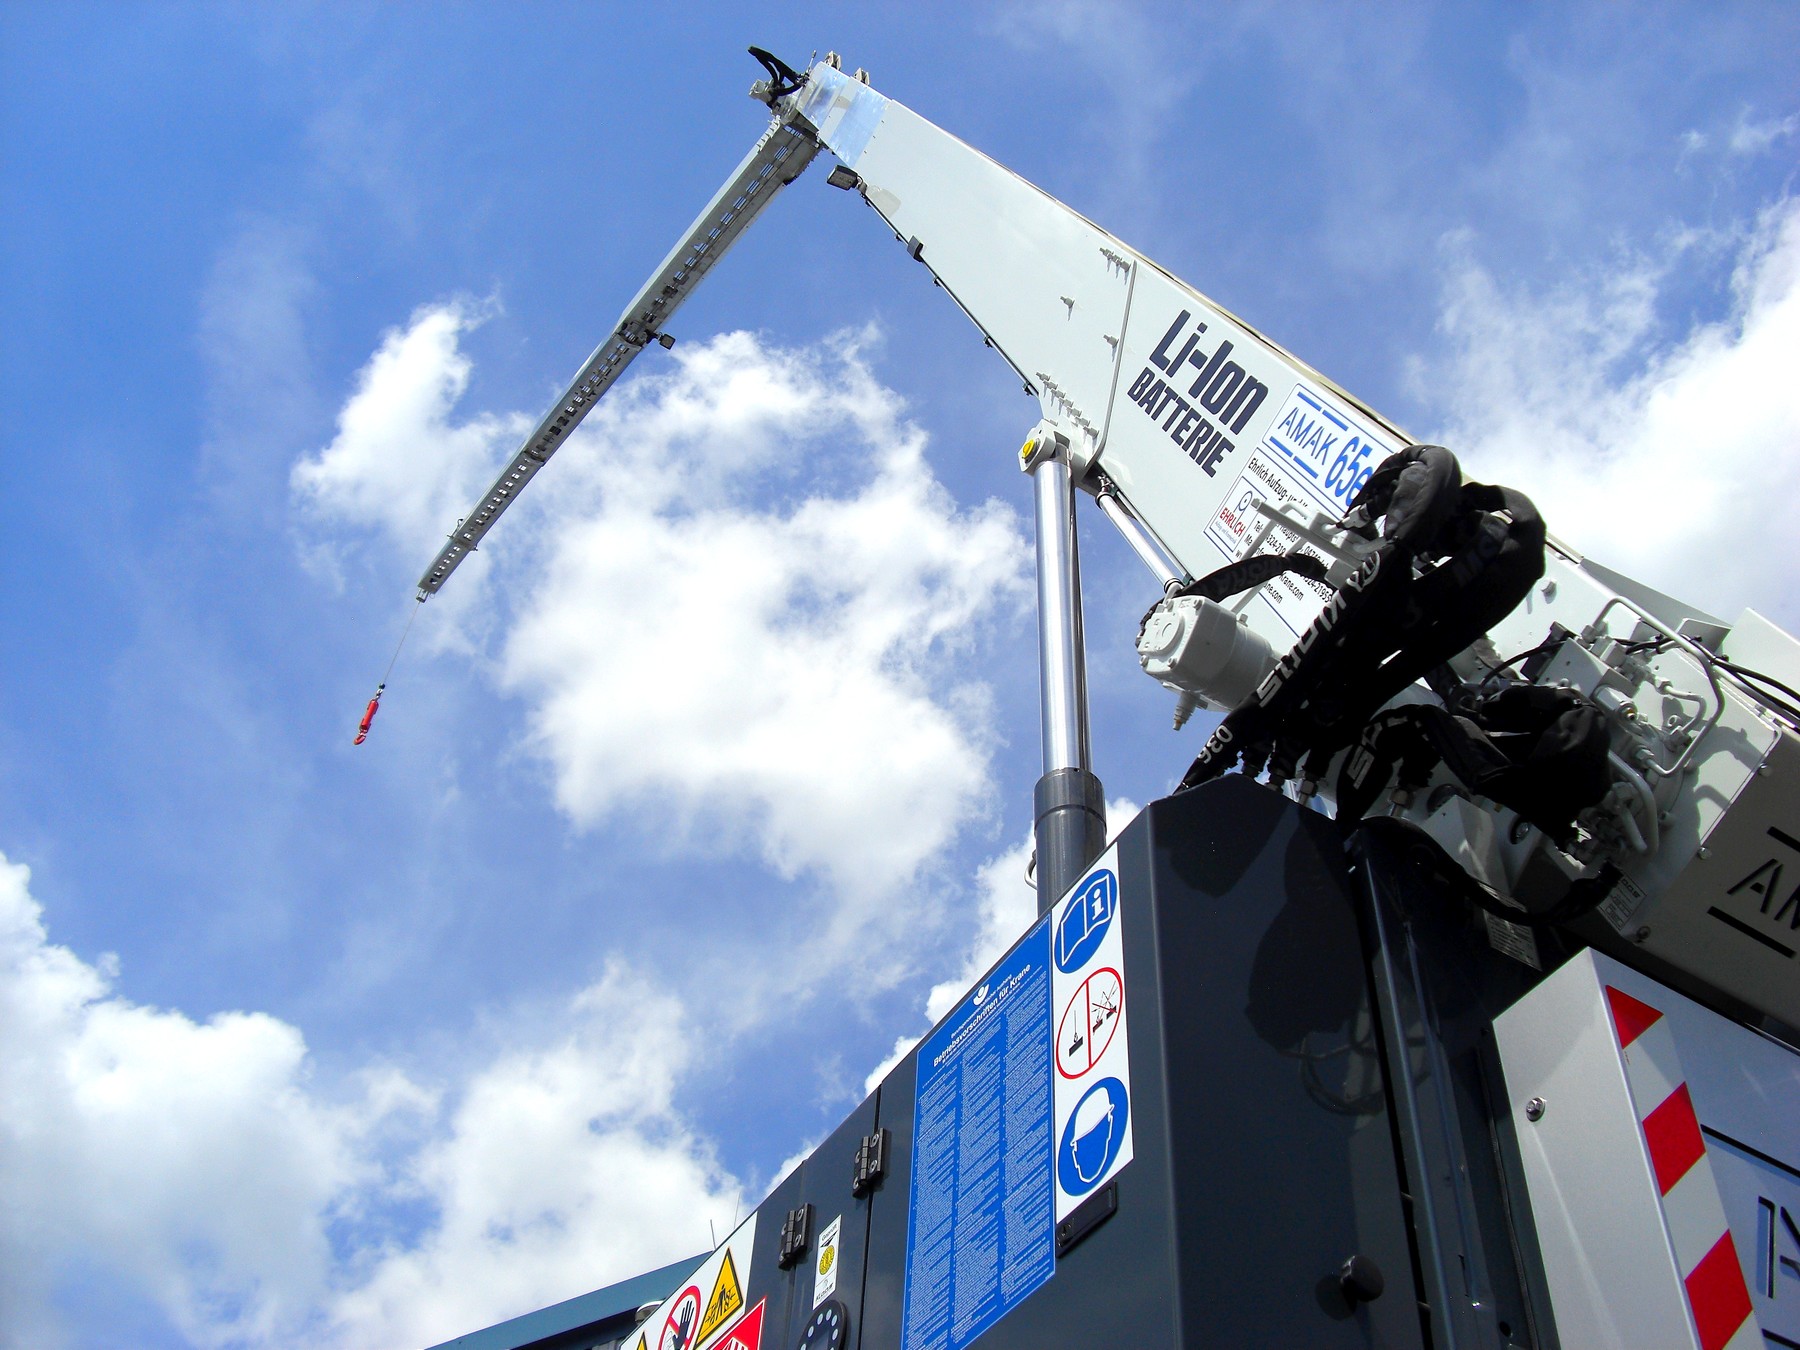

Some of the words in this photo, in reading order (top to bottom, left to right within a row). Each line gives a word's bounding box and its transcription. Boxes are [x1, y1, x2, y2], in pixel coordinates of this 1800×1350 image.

[1148, 309, 1269, 435] Li-Ion
[1126, 366, 1236, 479] BATTERIE
[1277, 406, 1338, 466] AMAK
[1248, 457, 1270, 482] Ehrlich
[1265, 473, 1289, 501] Aufzug-
[1219, 507, 1247, 537] EHRLICH
[1266, 534, 1287, 556] 324-219
[1279, 571, 1304, 602] Krane.com
[933, 998, 998, 1068] Betriebsvorschriften
